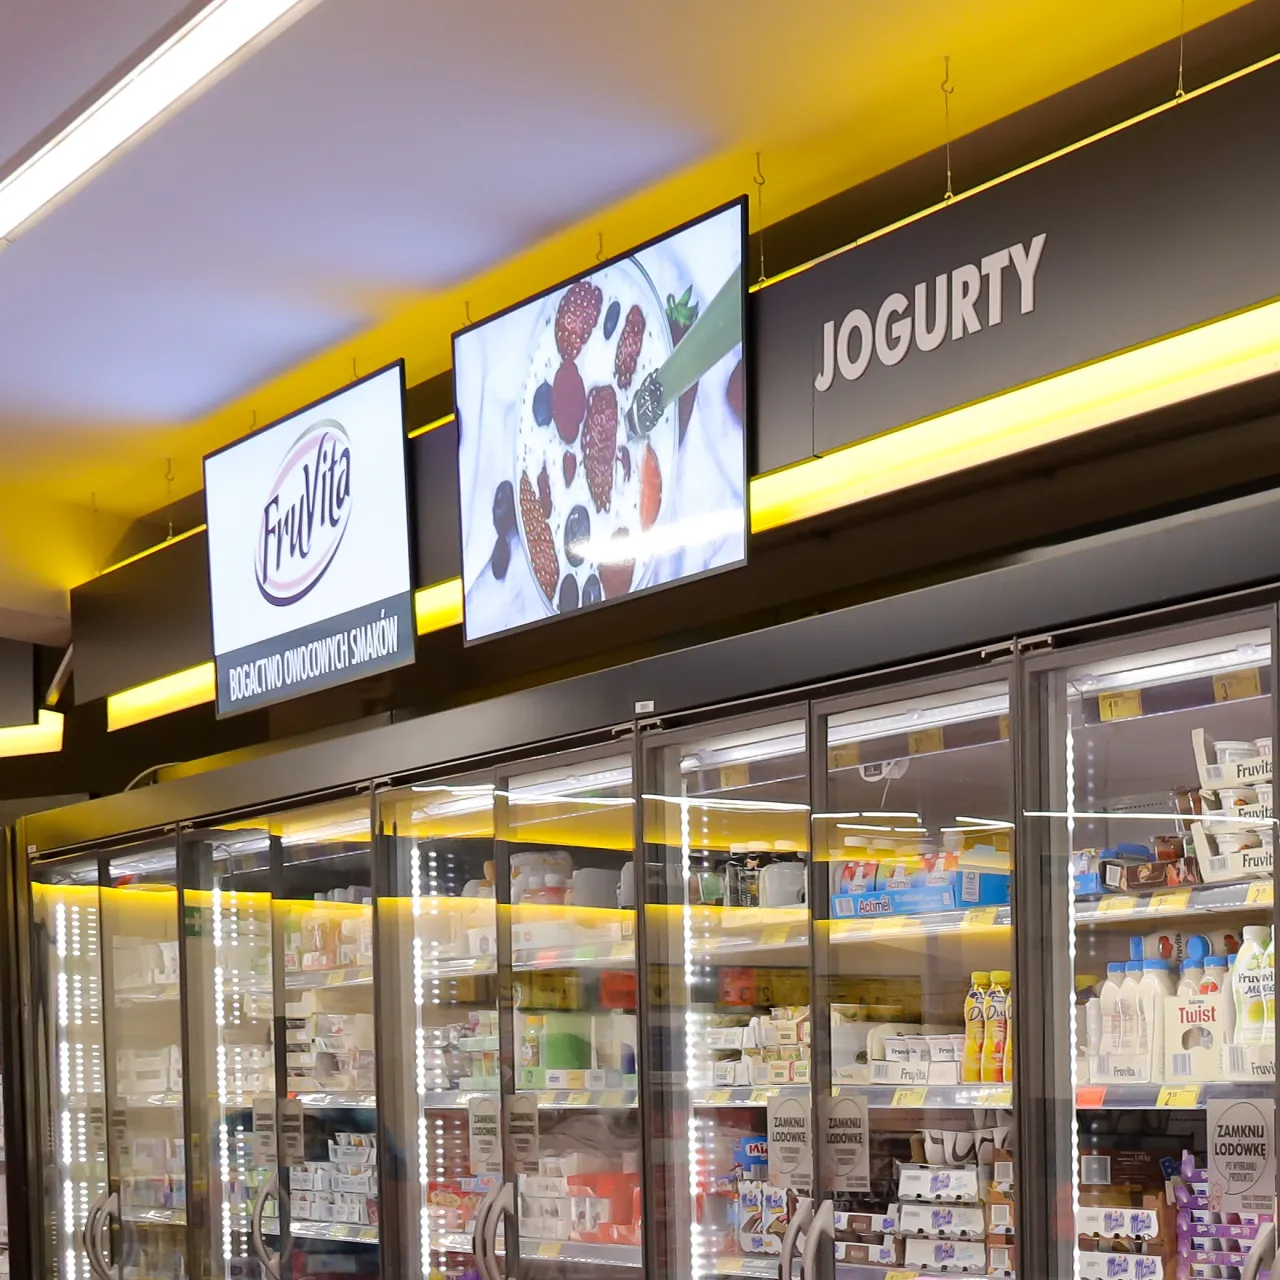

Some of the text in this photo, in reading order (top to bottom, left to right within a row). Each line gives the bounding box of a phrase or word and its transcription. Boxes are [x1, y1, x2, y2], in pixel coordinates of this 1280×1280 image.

[814, 234, 1046, 391] JOGURTY
[263, 433, 351, 583] FruVita
[229, 609, 398, 701] BOGACTWO OWOCOWYCH SMAKÓW
[858, 898, 890, 915] Actimel
[1178, 1006, 1216, 1023] Twist
[1217, 1125, 1265, 1140] ZAMKNIJ
[1214, 1143, 1266, 1159] LODÓWKĘ
